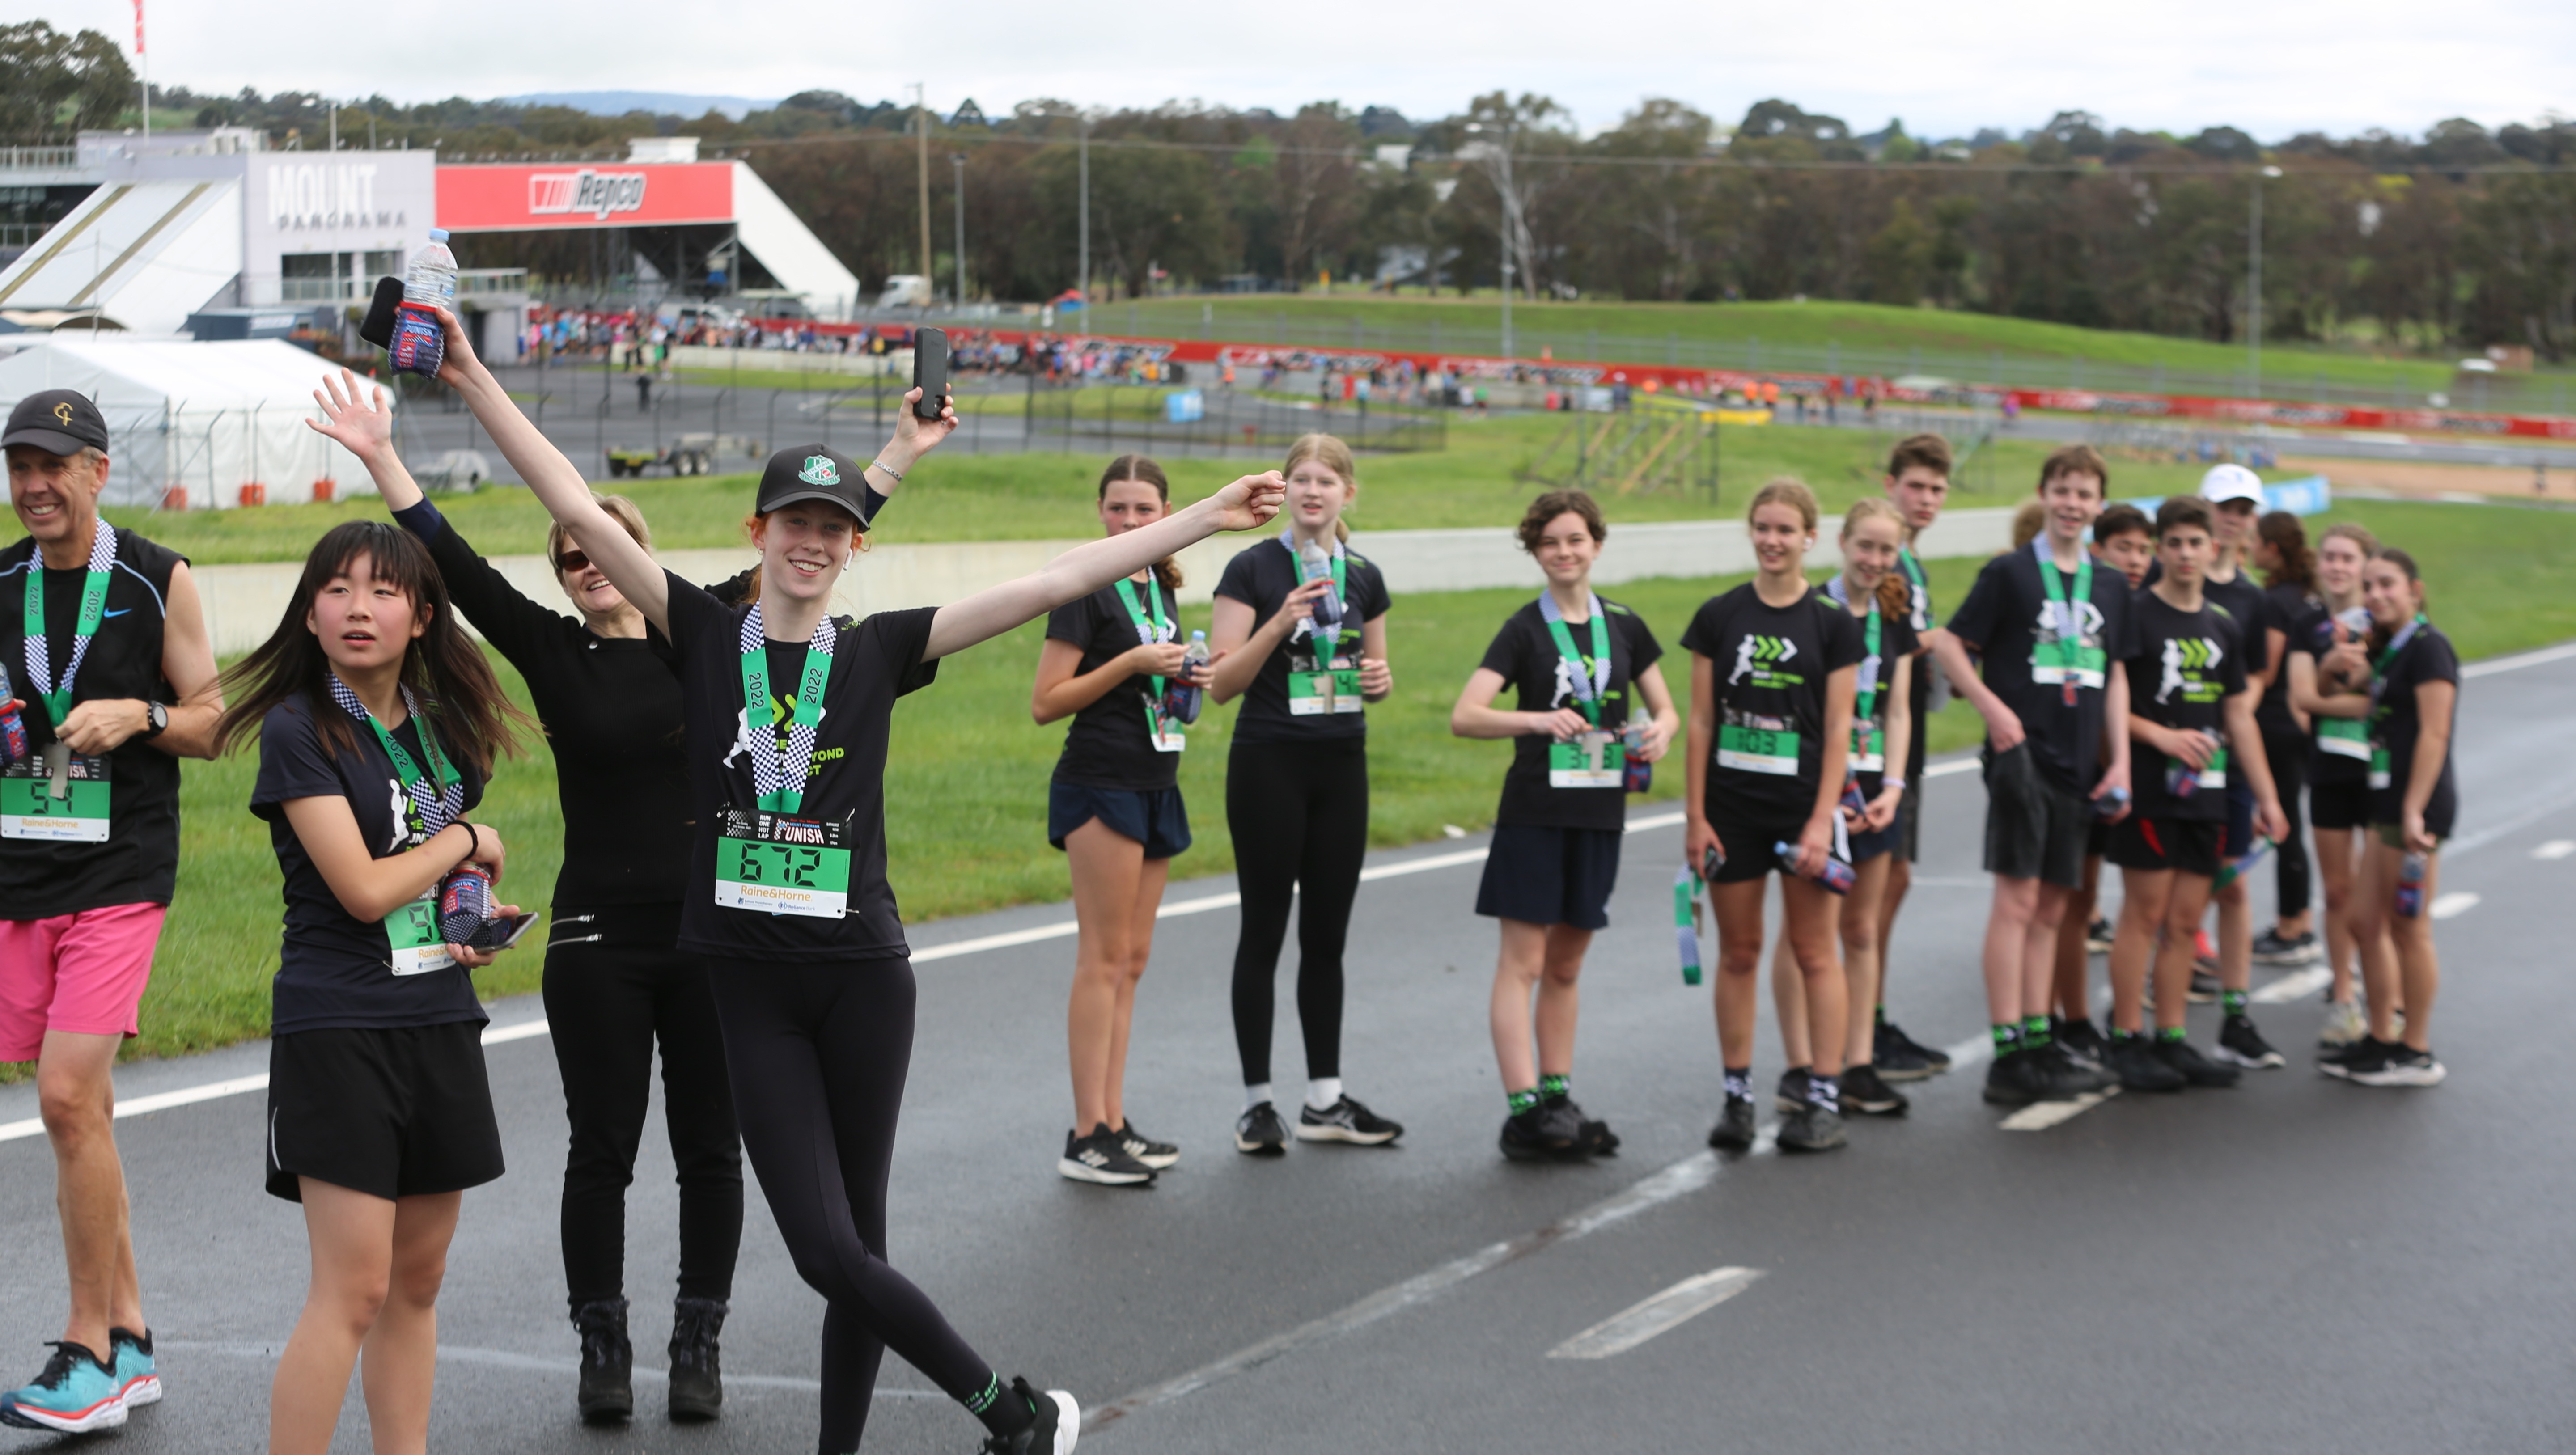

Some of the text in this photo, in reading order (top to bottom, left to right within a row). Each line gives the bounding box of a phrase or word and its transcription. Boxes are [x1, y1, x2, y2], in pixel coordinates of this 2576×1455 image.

[268, 164, 377, 225] MOUNT
[575, 171, 644, 218] Repco
[278, 211, 405, 231] PANORAMA
[85, 590, 101, 622] 2022
[749, 672, 764, 710] 2022
[803, 668, 823, 705] 2022
[385, 735, 409, 770] 2022
[1737, 730, 1777, 756] 103
[21, 817, 79, 829] Raine&Horne
[739, 843, 821, 888] 672
[445, 906, 457, 914] LAP
[741, 885, 811, 902] Raine&Horne
